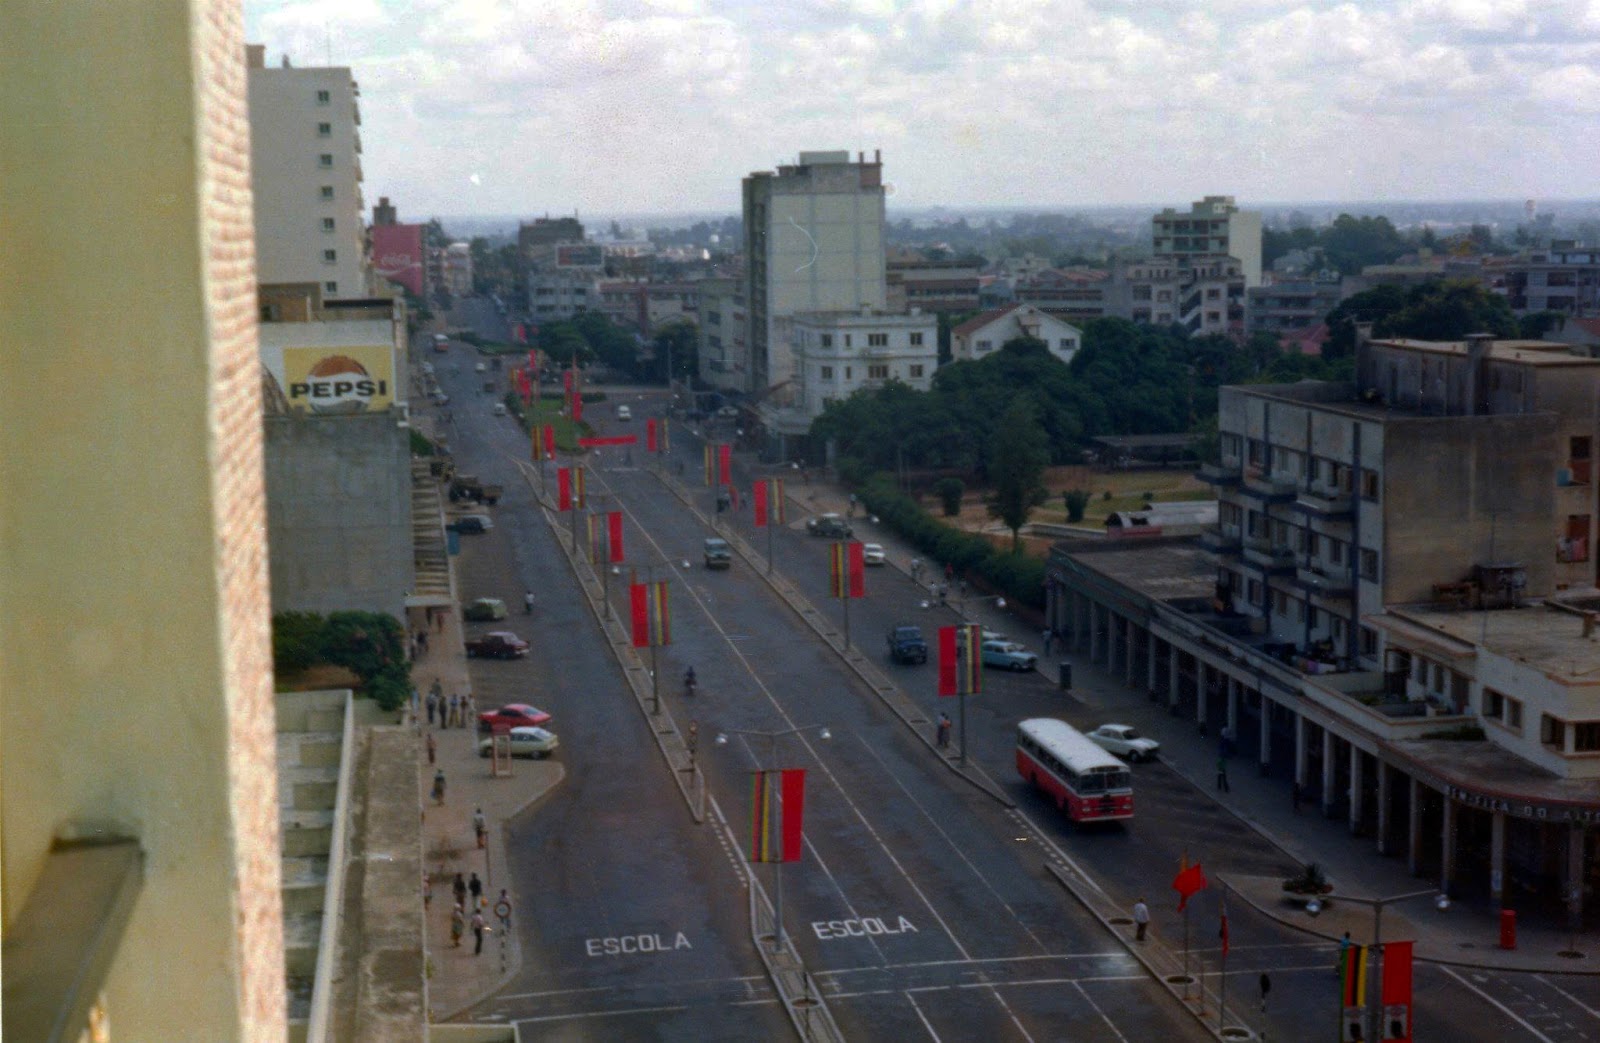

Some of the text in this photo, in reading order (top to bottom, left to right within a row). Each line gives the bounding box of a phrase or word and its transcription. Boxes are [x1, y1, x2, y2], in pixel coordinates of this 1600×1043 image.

[290, 380, 387, 398] PEPSI
[811, 916, 919, 940] ESCOLA
[585, 931, 692, 957] ESCOLA
